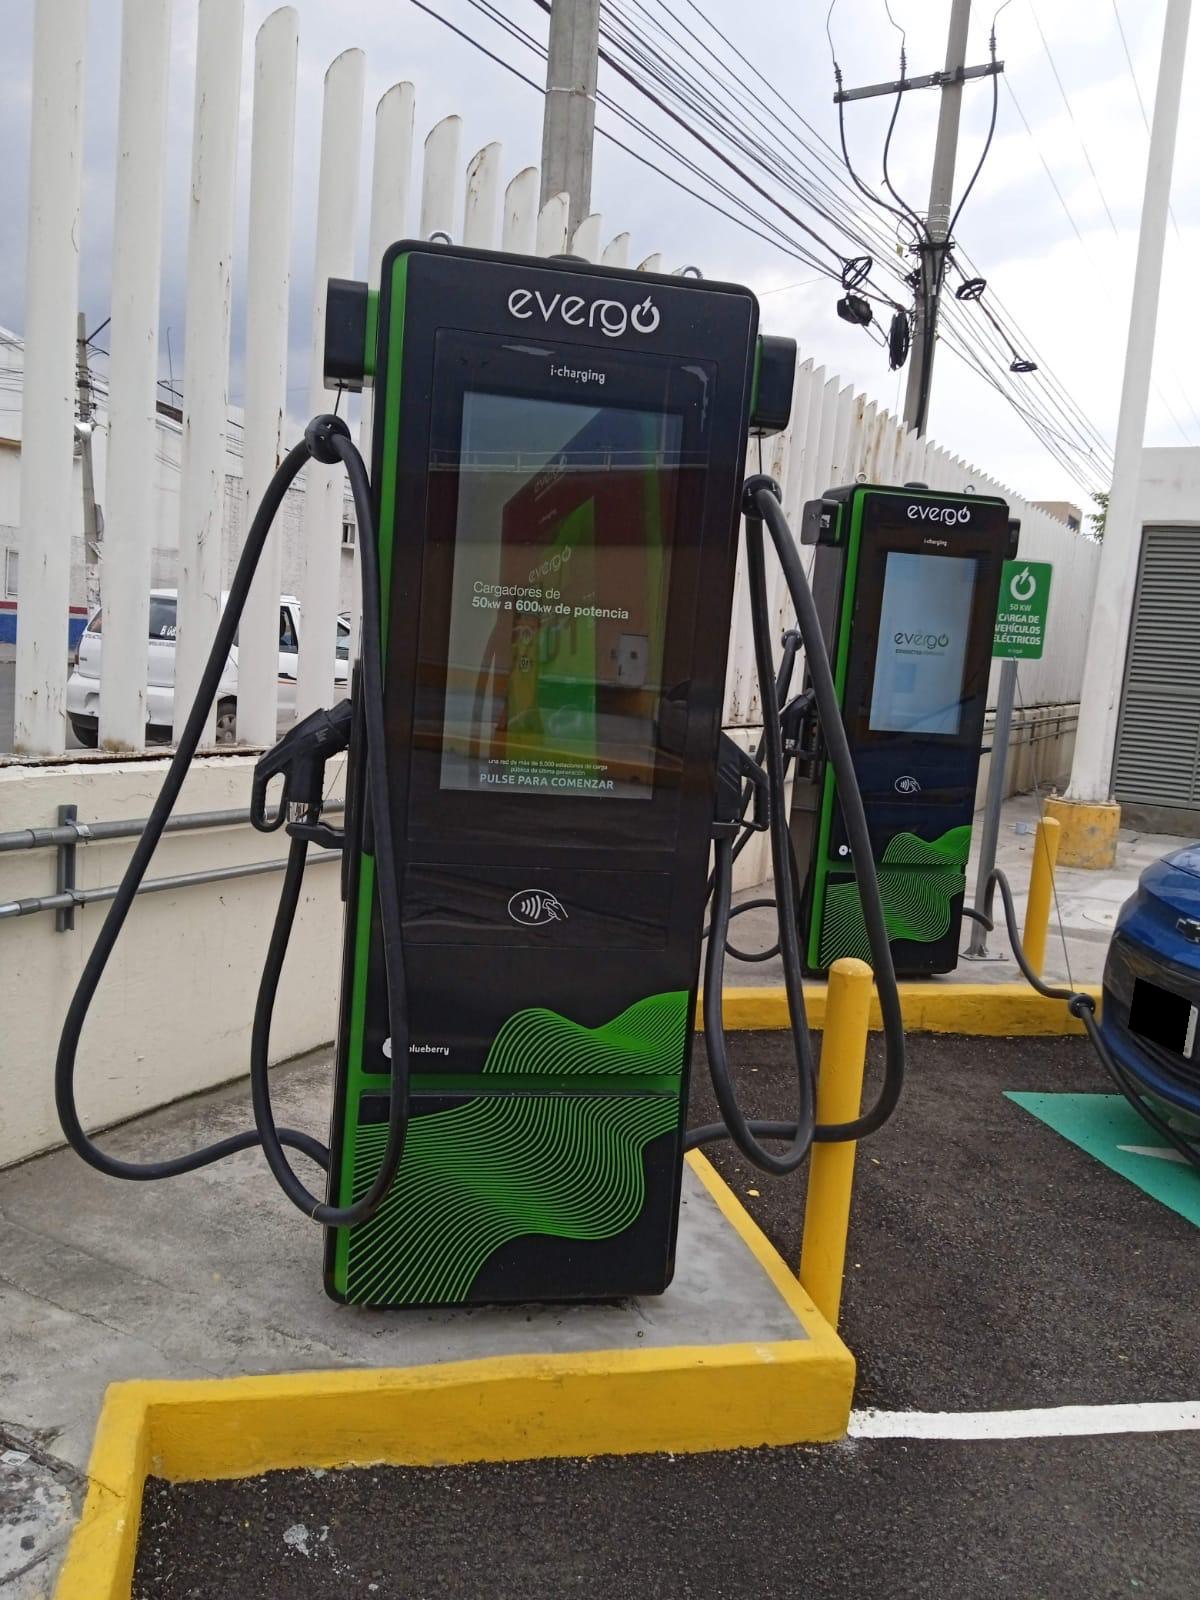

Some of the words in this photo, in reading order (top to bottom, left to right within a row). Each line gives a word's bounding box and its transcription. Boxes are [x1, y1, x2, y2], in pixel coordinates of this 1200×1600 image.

[507, 288, 661, 338] evergo
[906, 505, 971, 526] evergo
[473, 580, 542, 599] Cargadores
[545, 588, 561, 600] de
[504, 601, 512, 610] a
[554, 604, 571, 615] de
[573, 606, 629, 620] potencia
[998, 613, 1027, 623] CARGA
[1028, 615, 1040, 624] DE
[994, 622, 1041, 635] VEHÍCULOS
[894, 632, 949, 650] evergo
[480, 773, 515, 785] PULSE
[517, 775, 548, 787] PARA
[551, 777, 614, 790] COMENZAR
